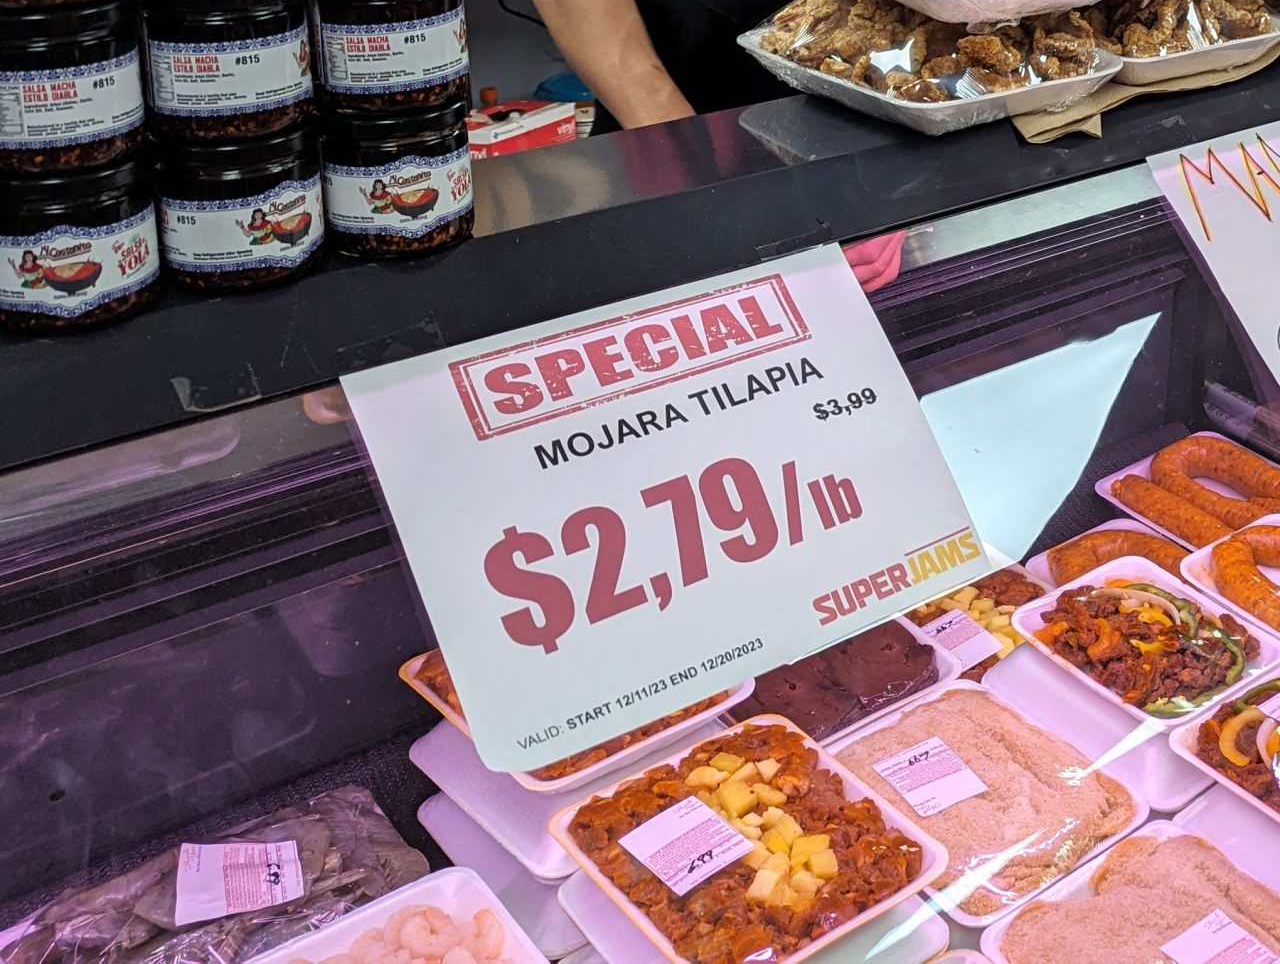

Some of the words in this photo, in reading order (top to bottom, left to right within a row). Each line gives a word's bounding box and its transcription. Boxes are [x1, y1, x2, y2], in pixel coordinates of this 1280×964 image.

[367, 36, 389, 44] MACHA
[404, 34, 426, 44] #815
[172, 56, 192, 64] SALSA
[195, 56, 218, 64] MACHA
[235, 54, 260, 66] #815
[174, 65, 193, 73] ESTILO
[22, 84, 46, 94] SALSA
[50, 81, 77, 91] MACHA
[93, 76, 115, 89] #815
[24, 94, 48, 103] ESTILO
[176, 215, 196, 225] #815
[121, 238, 145, 261] SALSA
[118, 244, 150, 276] YOLA
[483, 294, 784, 416] SPECIAL
[812, 386, 878, 423] $3,99
[533, 404, 687, 471] MOJARA
[687, 357, 825, 420] TILAPIA
[483, 456, 863, 655] $2,79/lb
[812, 532, 982, 627] SUPERJAMS
[515, 724, 564, 752] VALID:
[565, 700, 613, 731] START
[614, 679, 669, 710] 12/11/23
[668, 664, 699, 691] END
[699, 636, 764, 675] 12/20/2023
